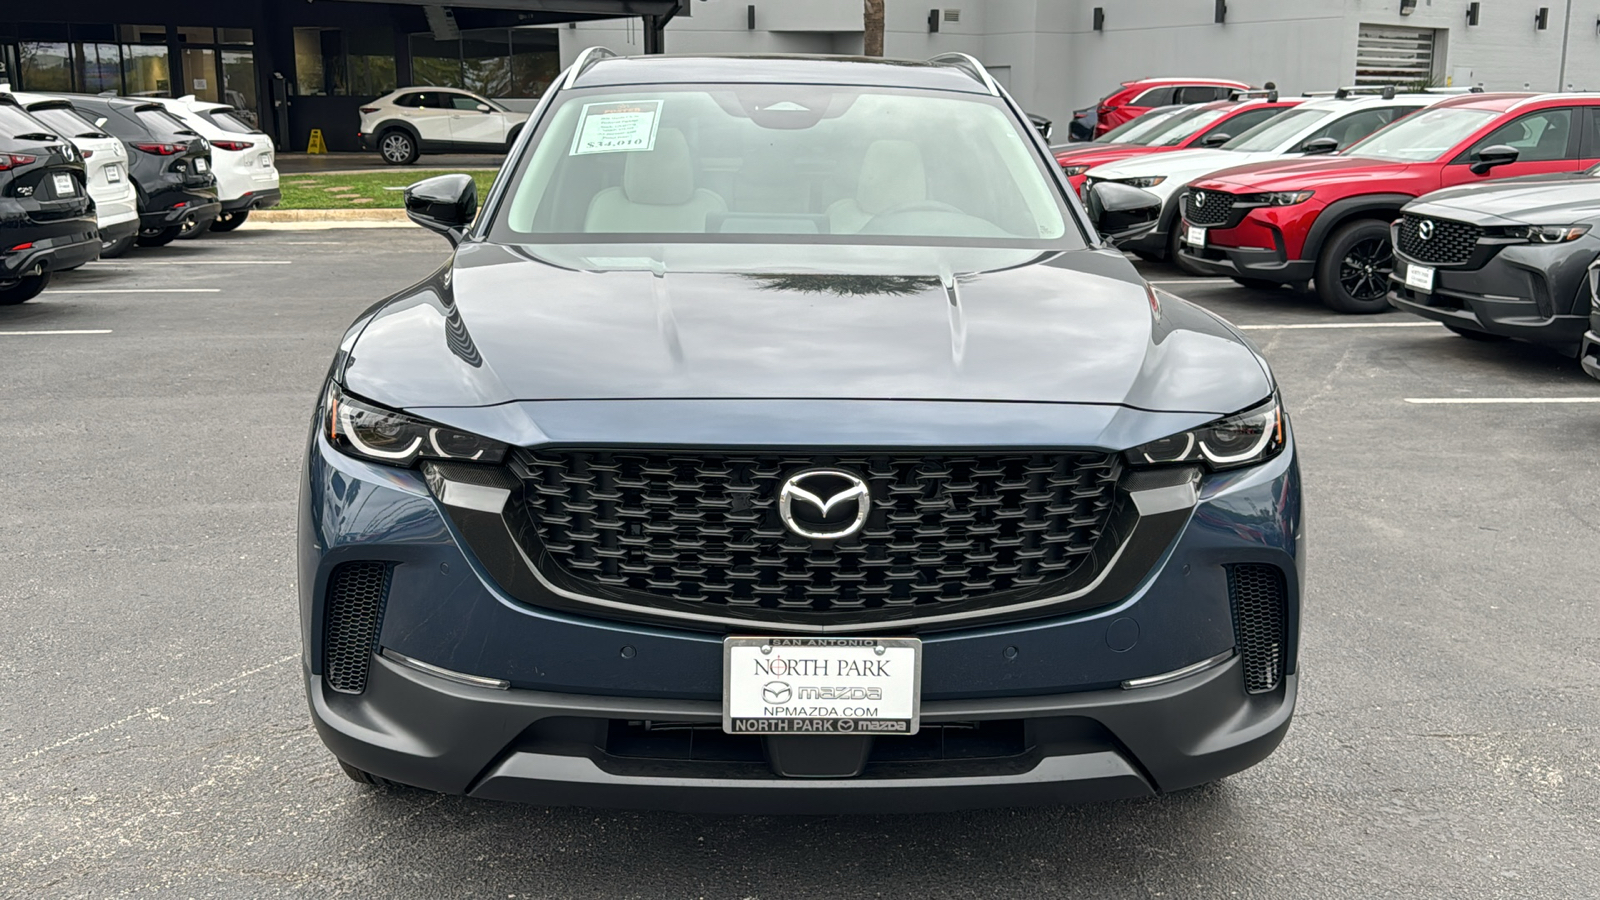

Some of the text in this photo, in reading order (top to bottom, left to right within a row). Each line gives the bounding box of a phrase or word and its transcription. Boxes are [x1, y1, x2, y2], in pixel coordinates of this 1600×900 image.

[772, 638, 874, 647] SAN ANTONIO
[754, 658, 891, 677] NORTH PARK
[763, 706, 879, 717] NPMAZDA.COM
[735, 719, 789, 732] NORTH
[794, 719, 834, 732] PARK
